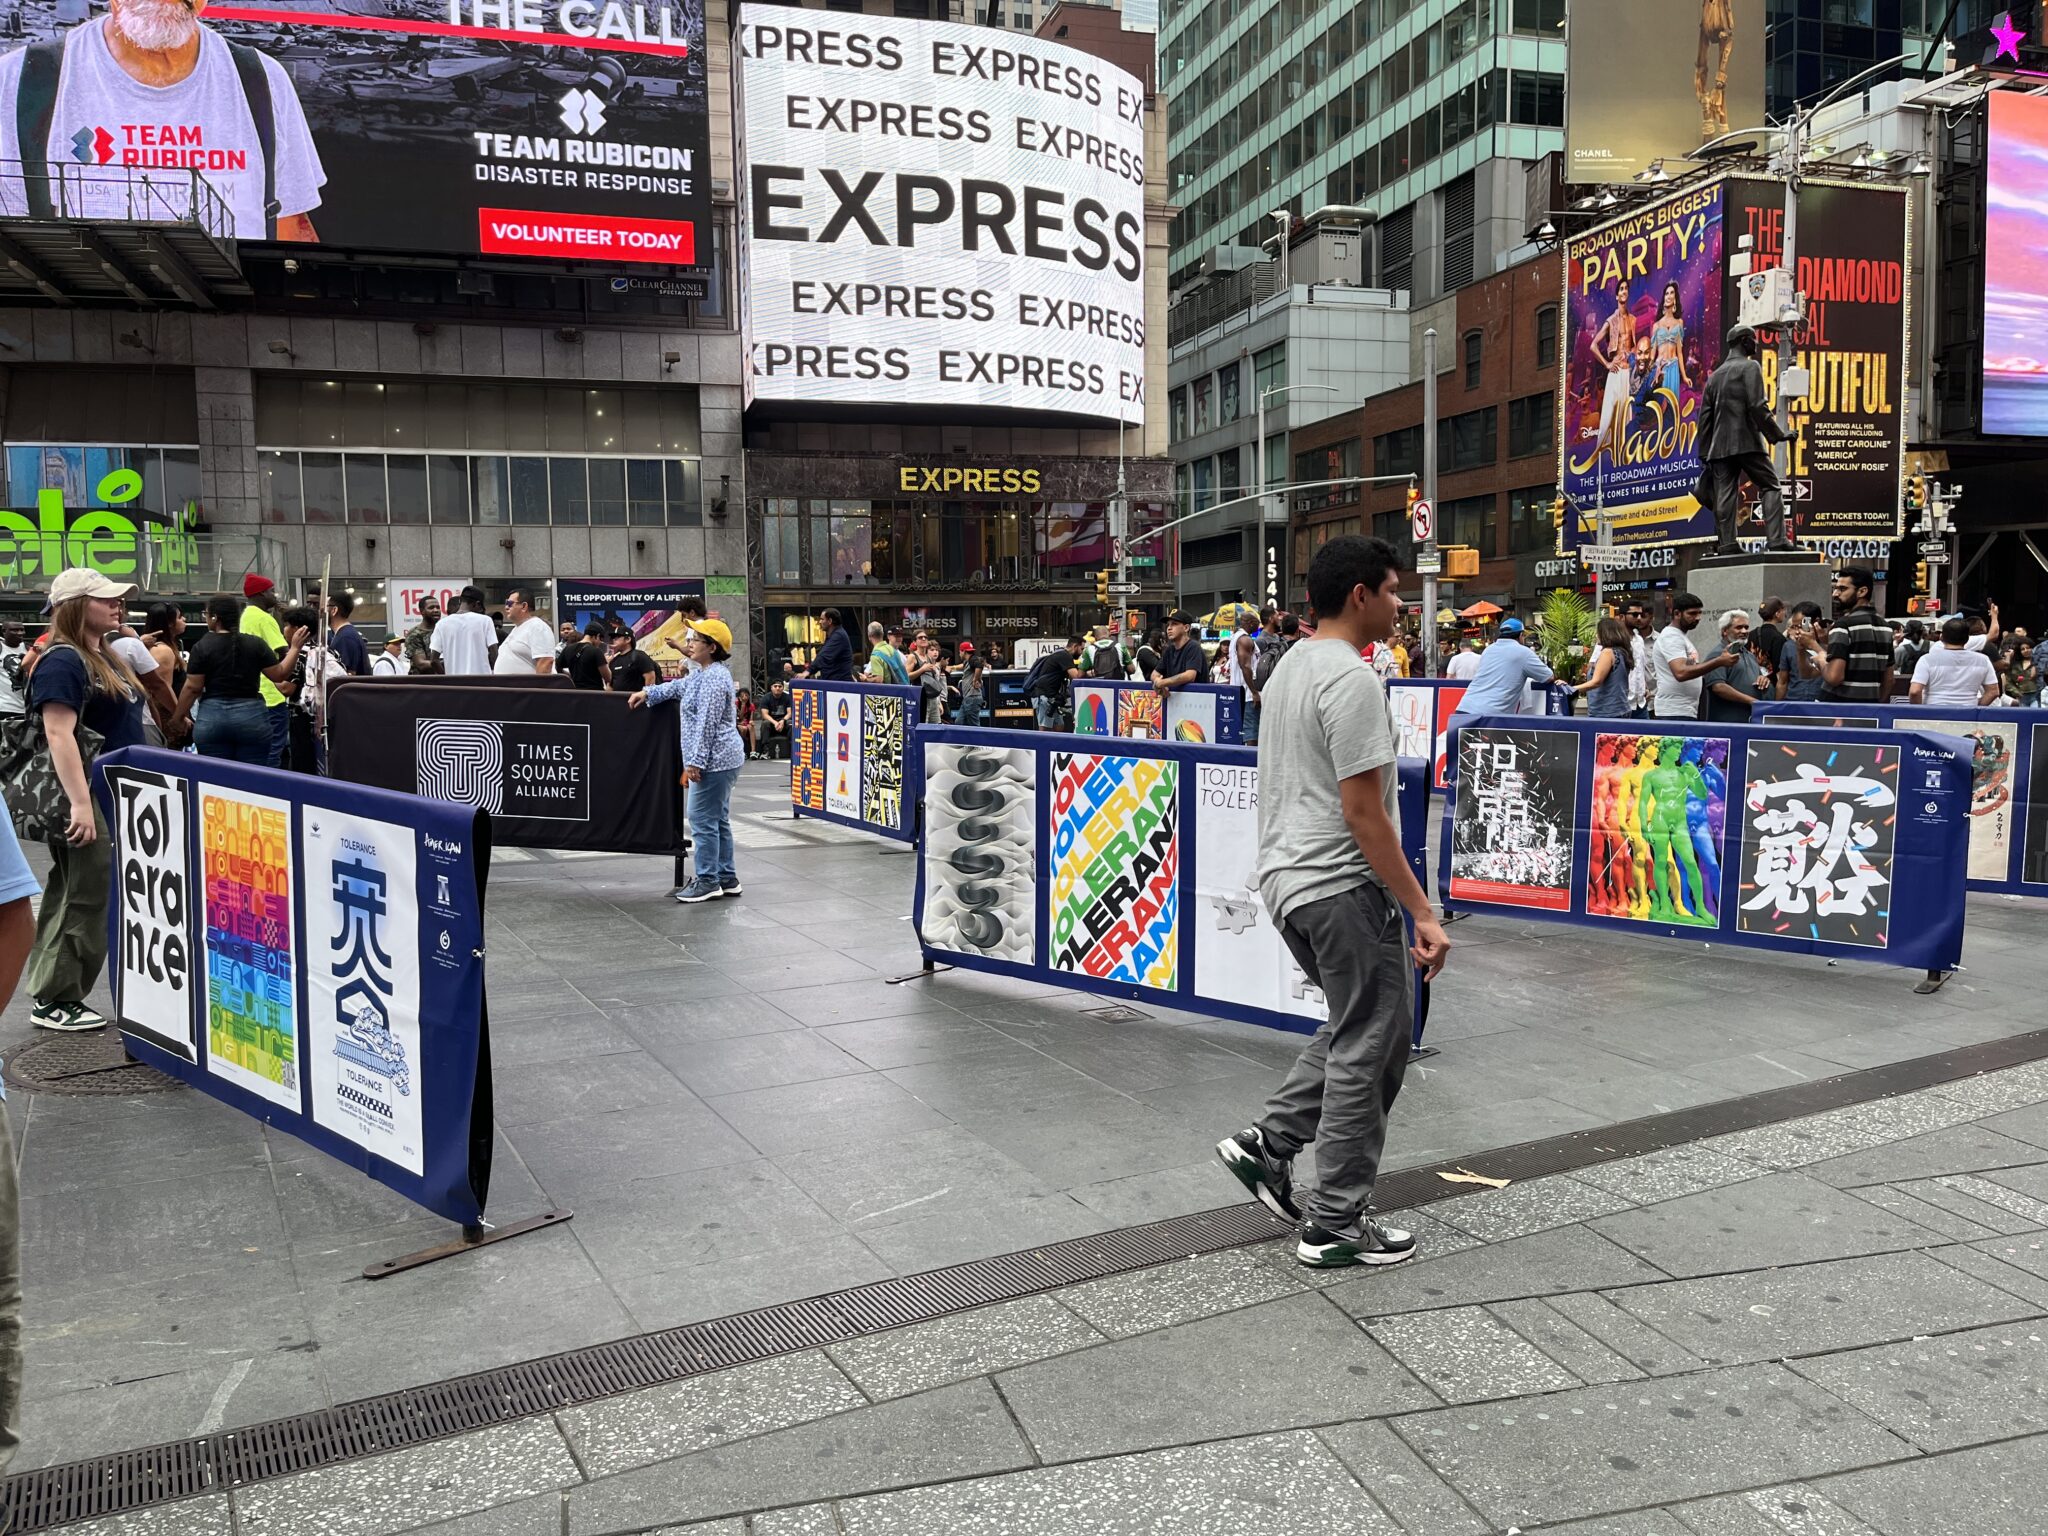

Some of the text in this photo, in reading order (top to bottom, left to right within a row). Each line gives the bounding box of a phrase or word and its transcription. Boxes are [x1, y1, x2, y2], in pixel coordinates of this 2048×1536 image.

[559, 0, 688, 46] CALL
[933, 41, 1101, 106] EXPRESS
[121, 125, 204, 147] TEAM
[787, 95, 1144, 187] EXPRESS EXPRESS
[122, 148, 246, 170] RUBICON
[474, 132, 693, 171] TEAM RUBICON
[1574, 149, 1613, 157] CHANEL
[475, 163, 693, 195] DISASTER RESPONSE
[751, 164, 1141, 282] EXPRESS
[1570, 184, 1721, 260] BROADWAY'S BIGGEST
[1745, 206, 1784, 253] THE
[492, 223, 683, 250] VOLUNTEER TODAY
[1583, 212, 1706, 296] PARTY!
[1797, 256, 1901, 304] DIAMOND
[793, 281, 1144, 348] EXPRESS EXPRESS
[939, 350, 1104, 395] EXPRESS
[1762, 350, 1892, 414] BAUTIFUL
[901, 467, 1042, 493] EXPRESS
[1580, 477, 1595, 488] THE
[1610, 466, 1658, 483] BROADWAY
[1659, 459, 1700, 475] MUSICAL
[1607, 488, 1630, 499] COMES
[1631, 485, 1650, 496] TRUE
[1651, 484, 1656, 493] 4
[1658, 480, 1687, 493] BLOCKS
[1628, 511, 1640, 520] and
[1641, 509, 1657, 519] 42nd
[1658, 505, 1678, 516] Street
[1815, 512, 1890, 520] GET TICKETS TODAY!
[1534, 558, 1576, 577] GIFTS
[564, 594, 581, 602] THE
[583, 594, 642, 602] OPPORTUNITY
[643, 594, 655, 602] OF
[656, 594, 663, 602] A
[1602, 583, 1626, 592] SONY
[902, 617, 957, 628] EXPRESS
[985, 616, 1038, 628] EXPRESS
[1168, 608, 1178, 618] P
[517, 743, 573, 762] TIMES
[511, 764, 580, 783] SQUARE
[515, 785, 576, 799] ALLIANCE
[340, 838, 377, 856] TOLERANCE
